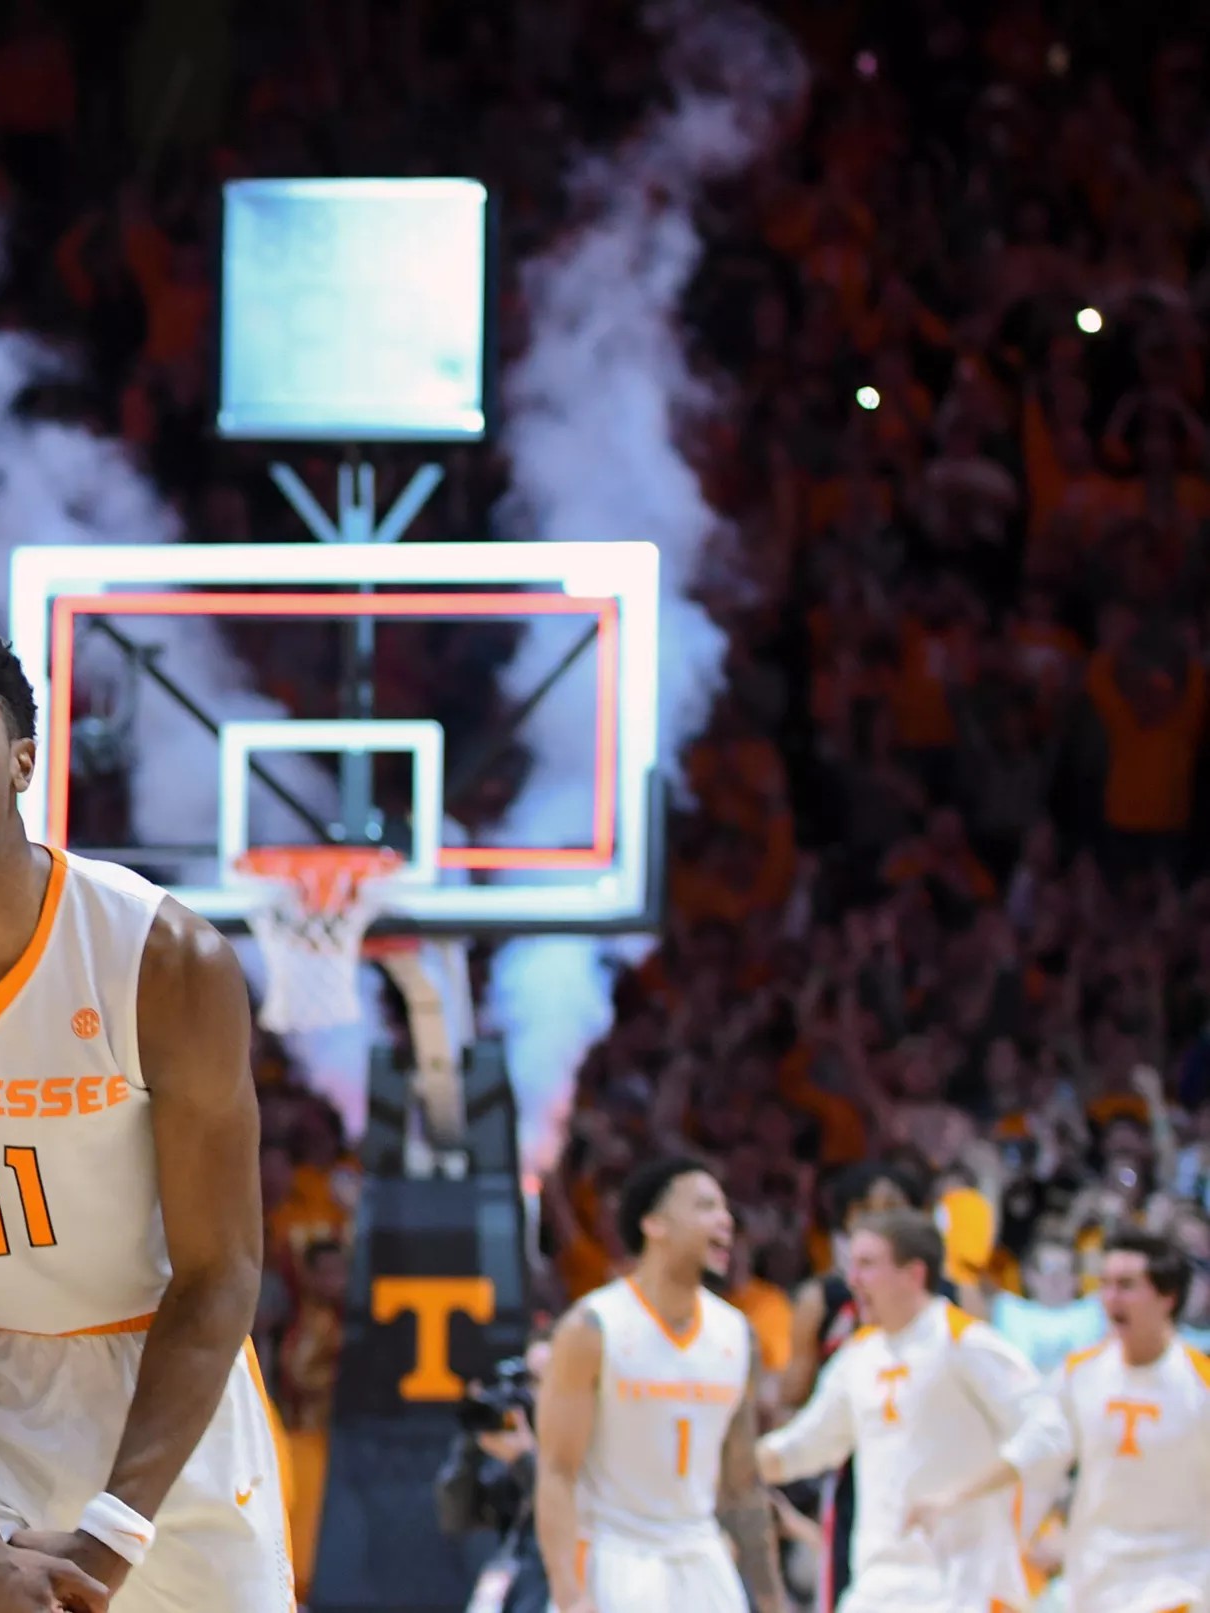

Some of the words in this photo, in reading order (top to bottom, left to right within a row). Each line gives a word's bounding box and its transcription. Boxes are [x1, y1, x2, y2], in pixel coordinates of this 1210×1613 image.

[371, 1275, 496, 1401] T
[875, 1363, 911, 1423] T
[674, 1417, 691, 1478] 1
[1105, 1399, 1163, 1458] T
